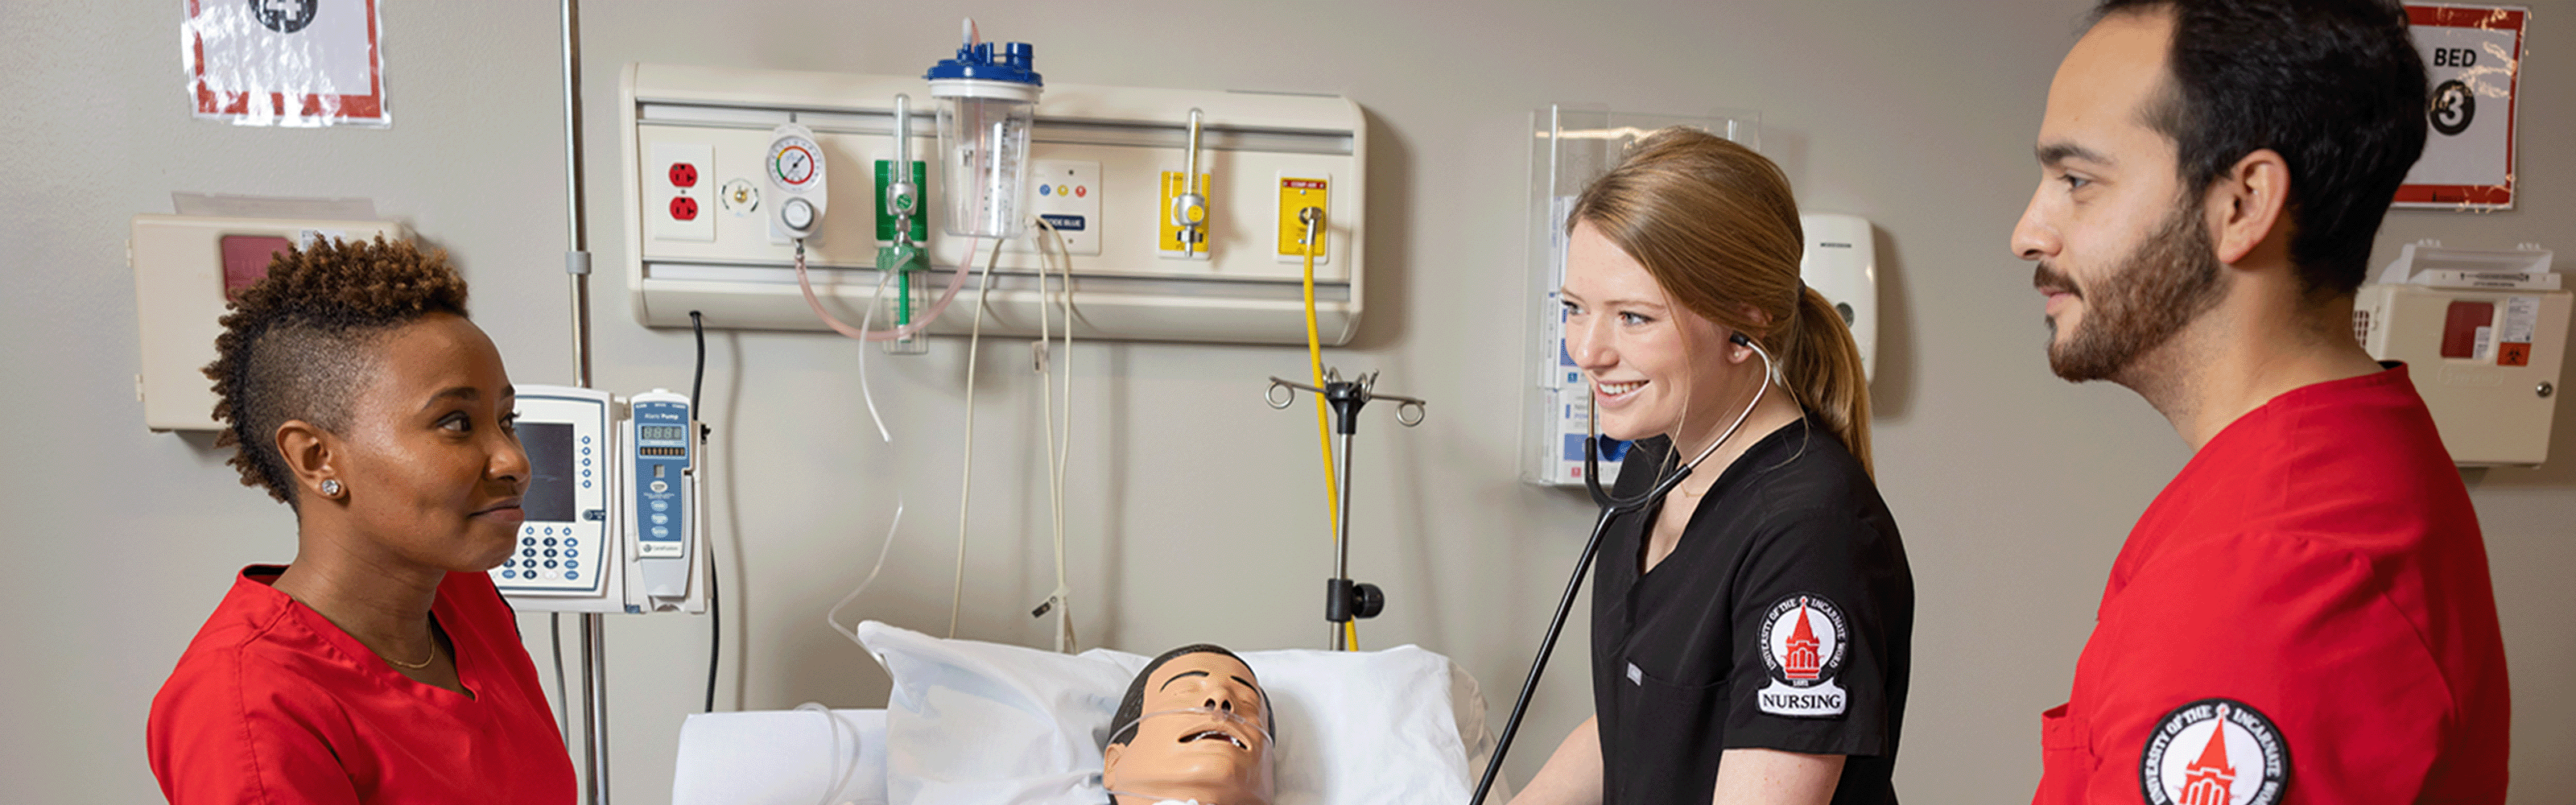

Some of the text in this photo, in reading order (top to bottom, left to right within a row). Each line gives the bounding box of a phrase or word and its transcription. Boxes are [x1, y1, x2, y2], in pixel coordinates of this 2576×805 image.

[2434, 48, 2476, 67] BED
[2438, 90, 2464, 126] 3
[1761, 598, 1798, 671] UNIVERSITY OF THE
[1811, 598, 1846, 668] INCARNATE WORD
[1763, 694, 1840, 708] NURSING
[2145, 704, 2213, 805] UNIVERSITY OF THE
[2232, 708, 2281, 805] INCARNATE WOR
